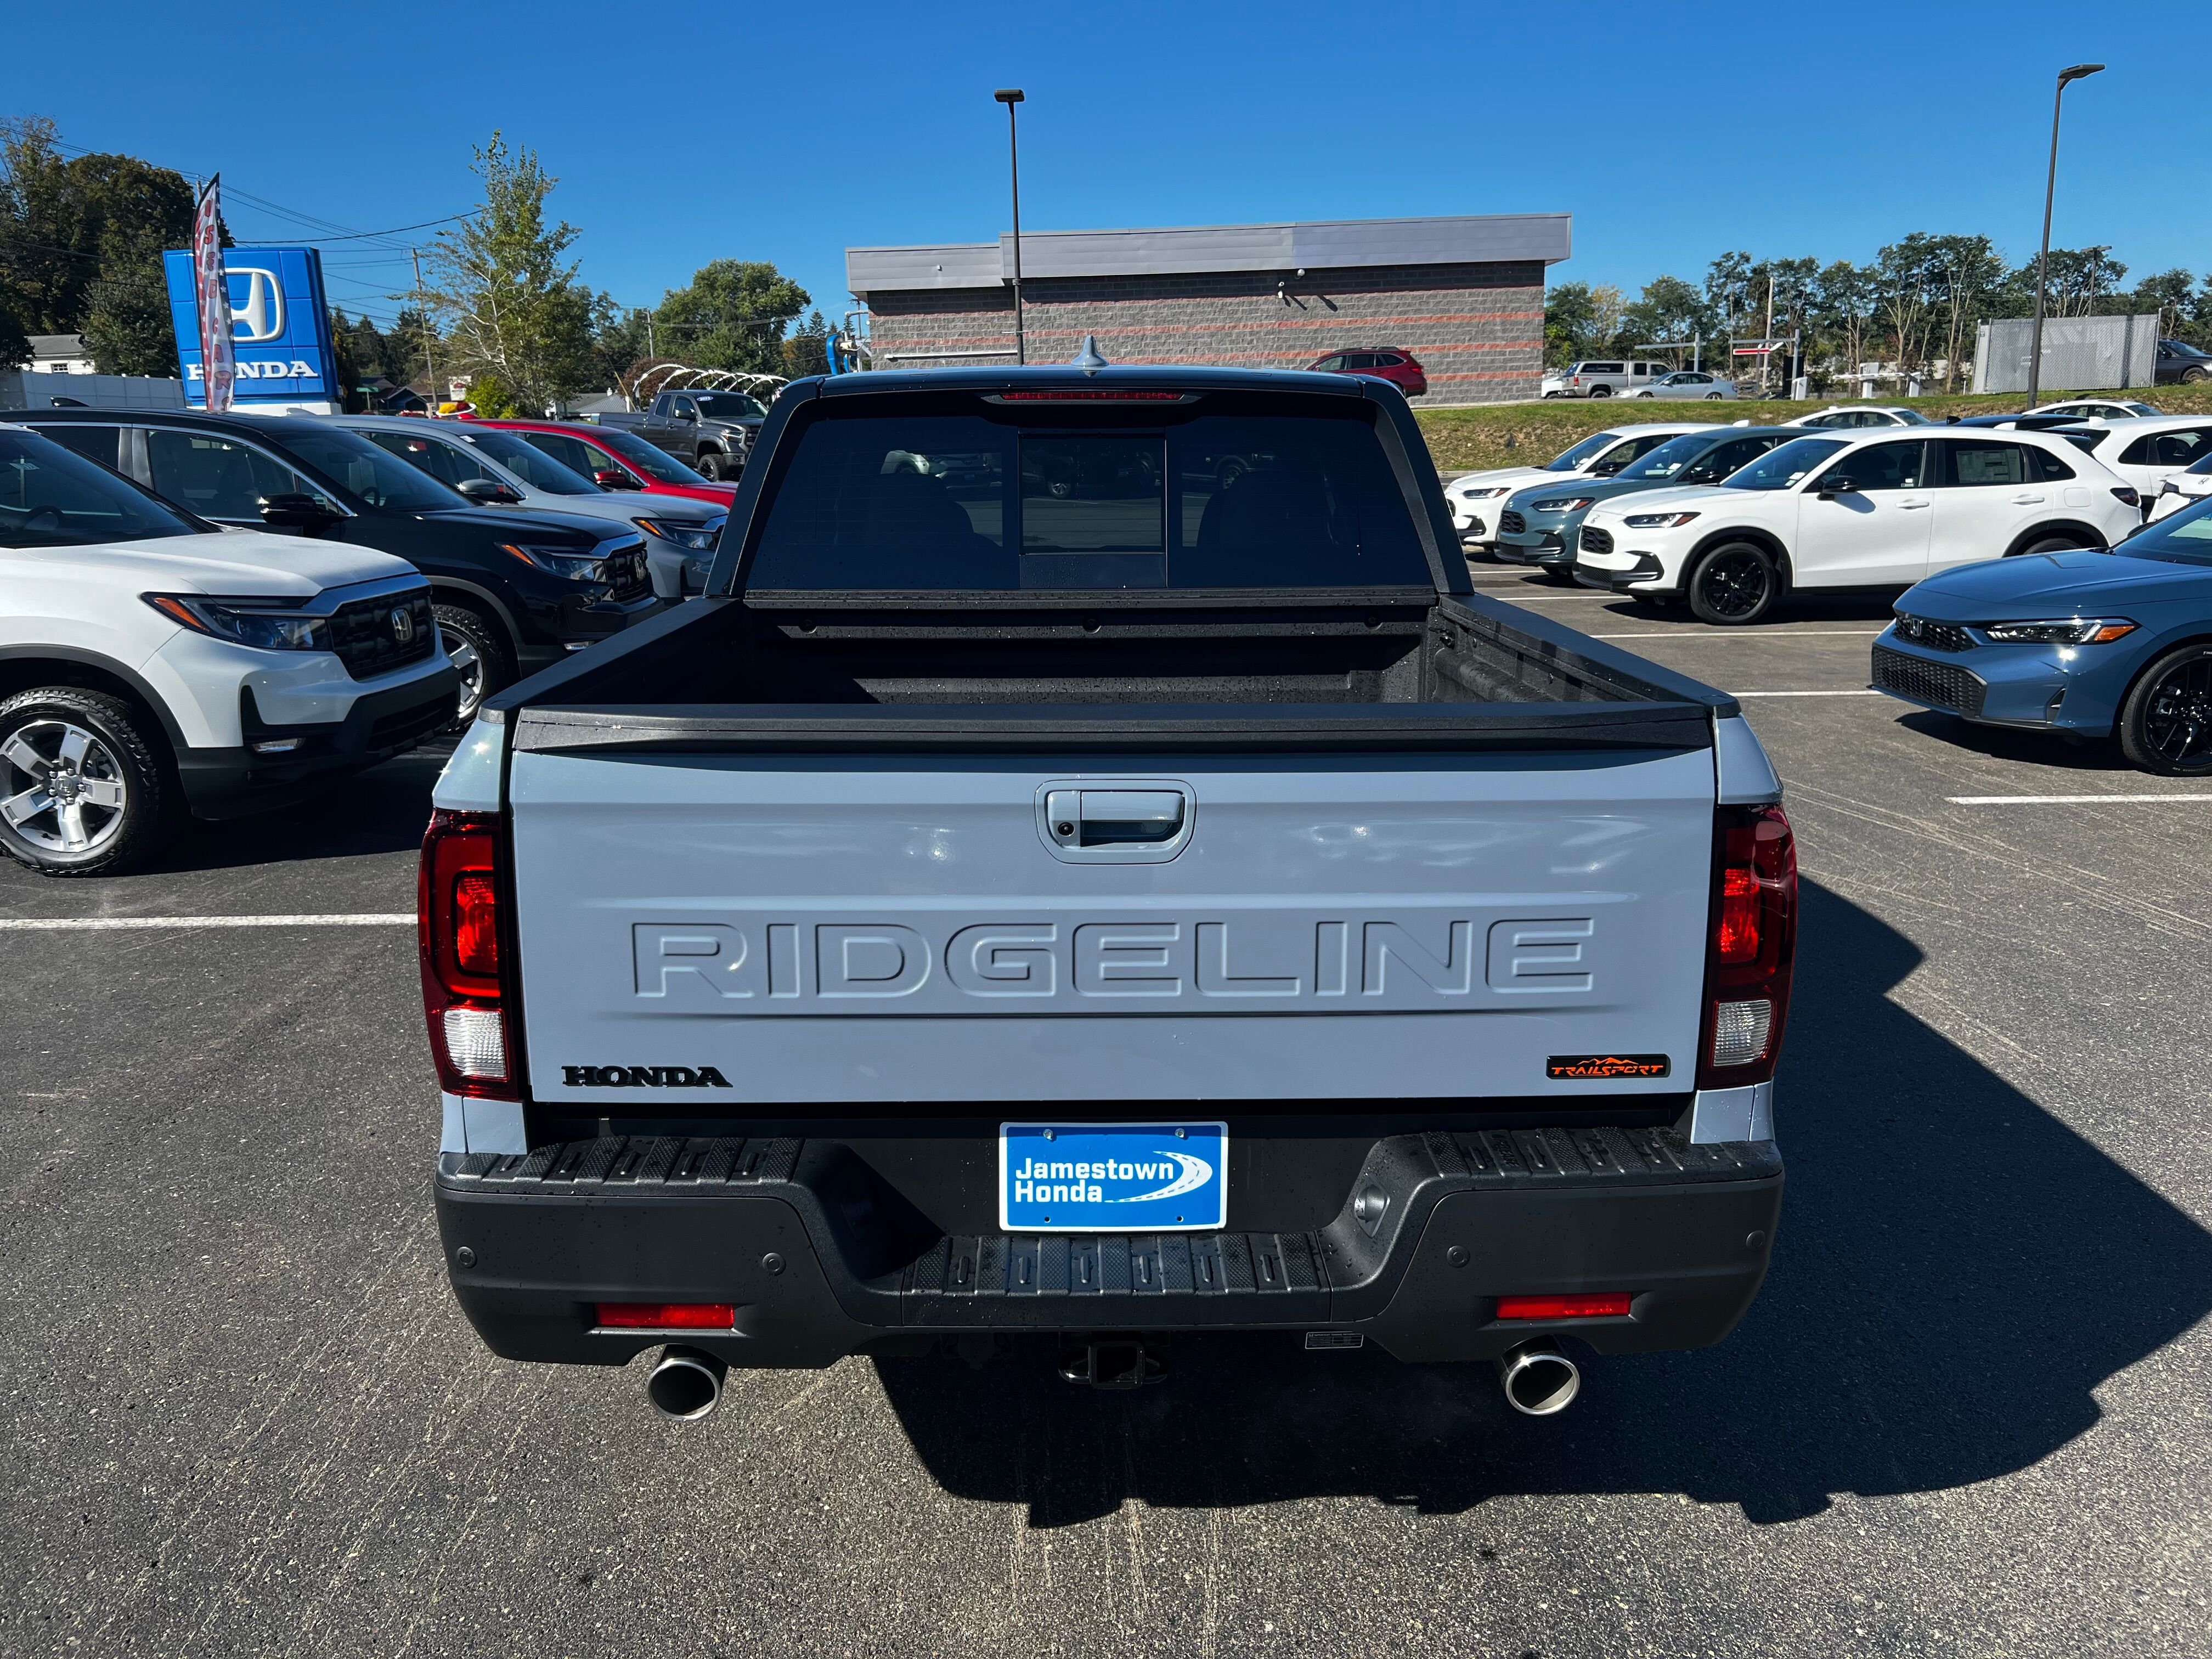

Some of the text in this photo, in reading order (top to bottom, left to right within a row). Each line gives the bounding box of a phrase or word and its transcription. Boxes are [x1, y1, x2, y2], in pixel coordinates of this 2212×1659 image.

[186, 360, 319, 381] HNDA
[631, 917, 1594, 998] RIDGELINE
[561, 1065, 733, 1088] HONDA
[1551, 1065, 1664, 1076] TRAILSPORT
[1015, 1158, 1174, 1180] Jamestown
[1015, 1180, 1102, 1203] Honda
